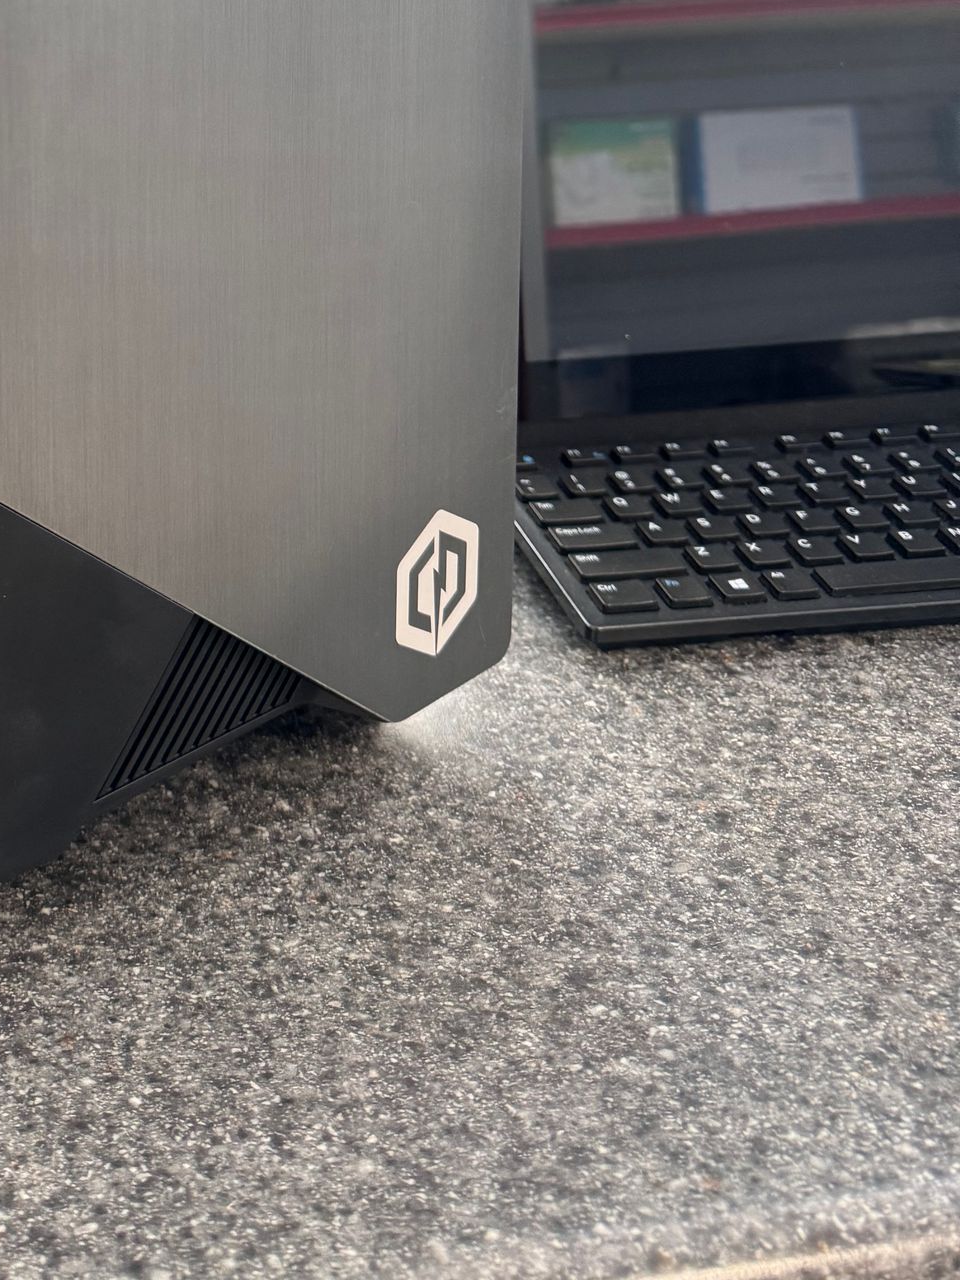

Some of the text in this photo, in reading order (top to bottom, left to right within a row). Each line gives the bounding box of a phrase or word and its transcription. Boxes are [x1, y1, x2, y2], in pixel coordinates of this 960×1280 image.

[852, 479, 866, 488] Y
[900, 476, 916, 485] U
[758, 486, 775, 496] R
[804, 482, 819, 492] T
[660, 492, 680, 504] W
[709, 490, 724, 500] E
[612, 496, 629, 508] Q
[946, 500, 957, 509] J
[845, 506, 860, 516] G
[892, 503, 911, 513] H
[744, 514, 761, 524] D
[795, 510, 808, 520] F
[648, 521, 662, 532] A
[696, 517, 712, 528] S
[578, 525, 601, 534] Lock
[846, 534, 860, 544] V
[897, 530, 913, 540] B
[744, 542, 762, 552] X
[797, 538, 812, 548] C
[693, 546, 710, 556] Z
[575, 554, 600, 562] Shift
[596, 583, 618, 592] Ctrl
